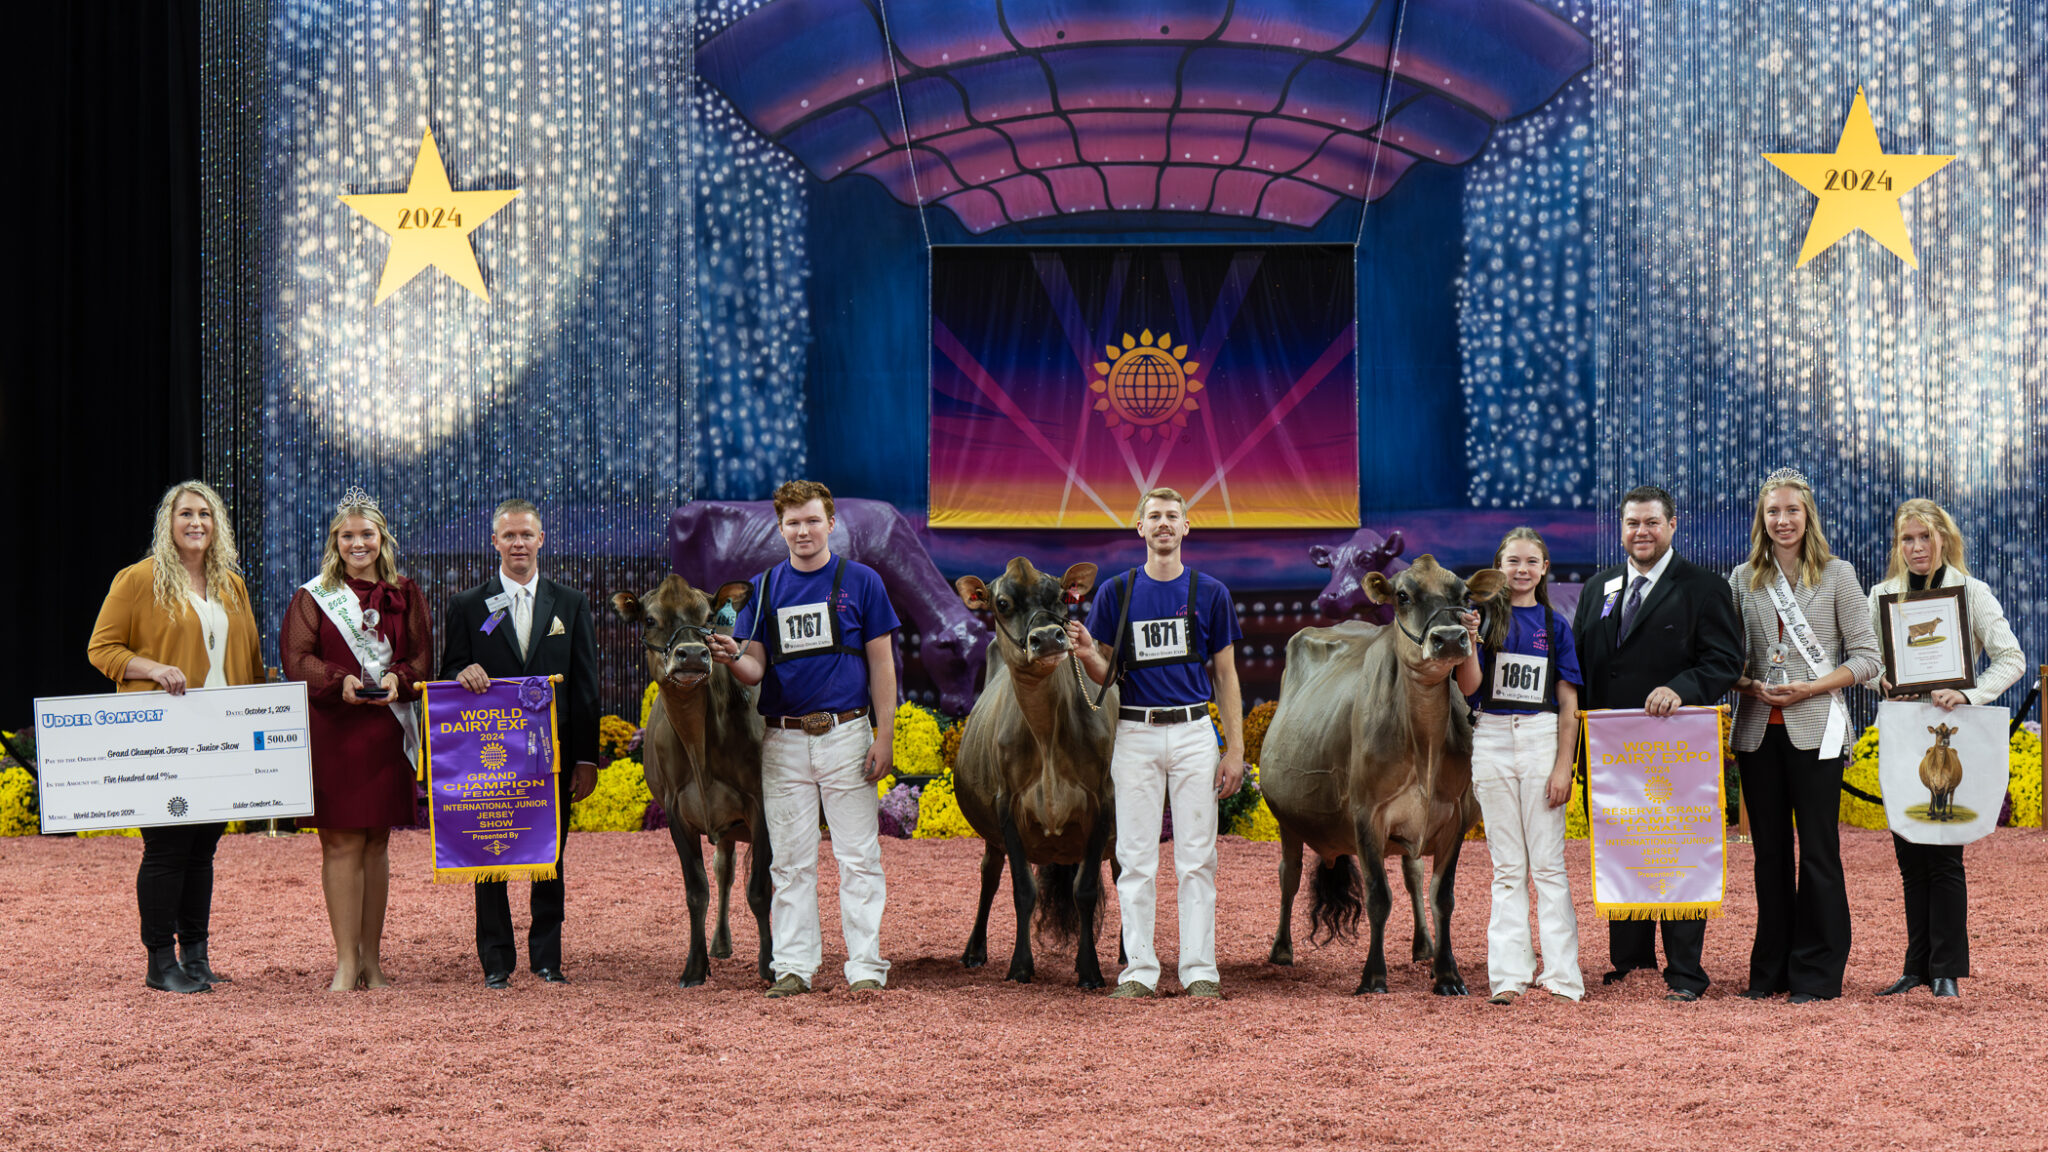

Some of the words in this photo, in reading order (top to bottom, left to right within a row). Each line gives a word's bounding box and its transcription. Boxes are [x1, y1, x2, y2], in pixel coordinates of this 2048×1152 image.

[1824, 169, 1892, 191] 2024
[398, 206, 462, 229] 2024
[337, 607, 365, 642] National
[786, 612, 821, 639] 1767
[1141, 621, 1178, 648] 1871
[1806, 644, 1823, 664] 2024
[1502, 662, 1541, 691] 1861
[245, 707, 267, 716] October
[275, 705, 290, 713] 2024
[460, 708, 523, 721] WORLD
[42, 713, 92, 728] UDDER
[95, 709, 163, 725] COMFORT
[441, 721, 493, 733] DAIRY
[267, 734, 298, 744] 500.00
[480, 733, 504, 741] 2024
[107, 748, 129, 758] Grand
[130, 746, 165, 758] Champion
[167, 745, 188, 755] Jersey
[196, 743, 219, 752] Junior
[220, 742, 240, 750] Show
[1623, 741, 1689, 752] WORLD
[1602, 753, 1657, 765] DAIRY
[1662, 751, 1712, 764] EXPO
[1644, 765, 1671, 774] 2024
[103, 775, 117, 784] Five
[118, 774, 145, 783] Hundred
[467, 771, 517, 781] GRAND
[443, 779, 545, 791] CHAMPION
[463, 789, 526, 798] FEMALE
[250, 800, 271, 808] Comfort
[443, 802, 513, 811] INTERNATIONAL
[514, 799, 548, 809] JUNIOR
[73, 812, 89, 820] World
[107, 810, 120, 818] Expo
[476, 810, 515, 820] JERSEY
[1602, 807, 1663, 816] RESERVE
[1666, 805, 1712, 815] GRAND
[479, 819, 513, 828] SHOW
[1605, 815, 1712, 825] CHAMPION
[1626, 824, 1693, 833] FEMALE
[509, 832, 519, 840] By
[1605, 838, 1678, 847] INTERNATIONAL
[1680, 836, 1715, 846] JUNIOR
[1641, 847, 1681, 856] JERSEY
[1644, 856, 1679, 865] SHOW
[1638, 870, 1674, 878] Presented
[1676, 870, 1686, 879] By
